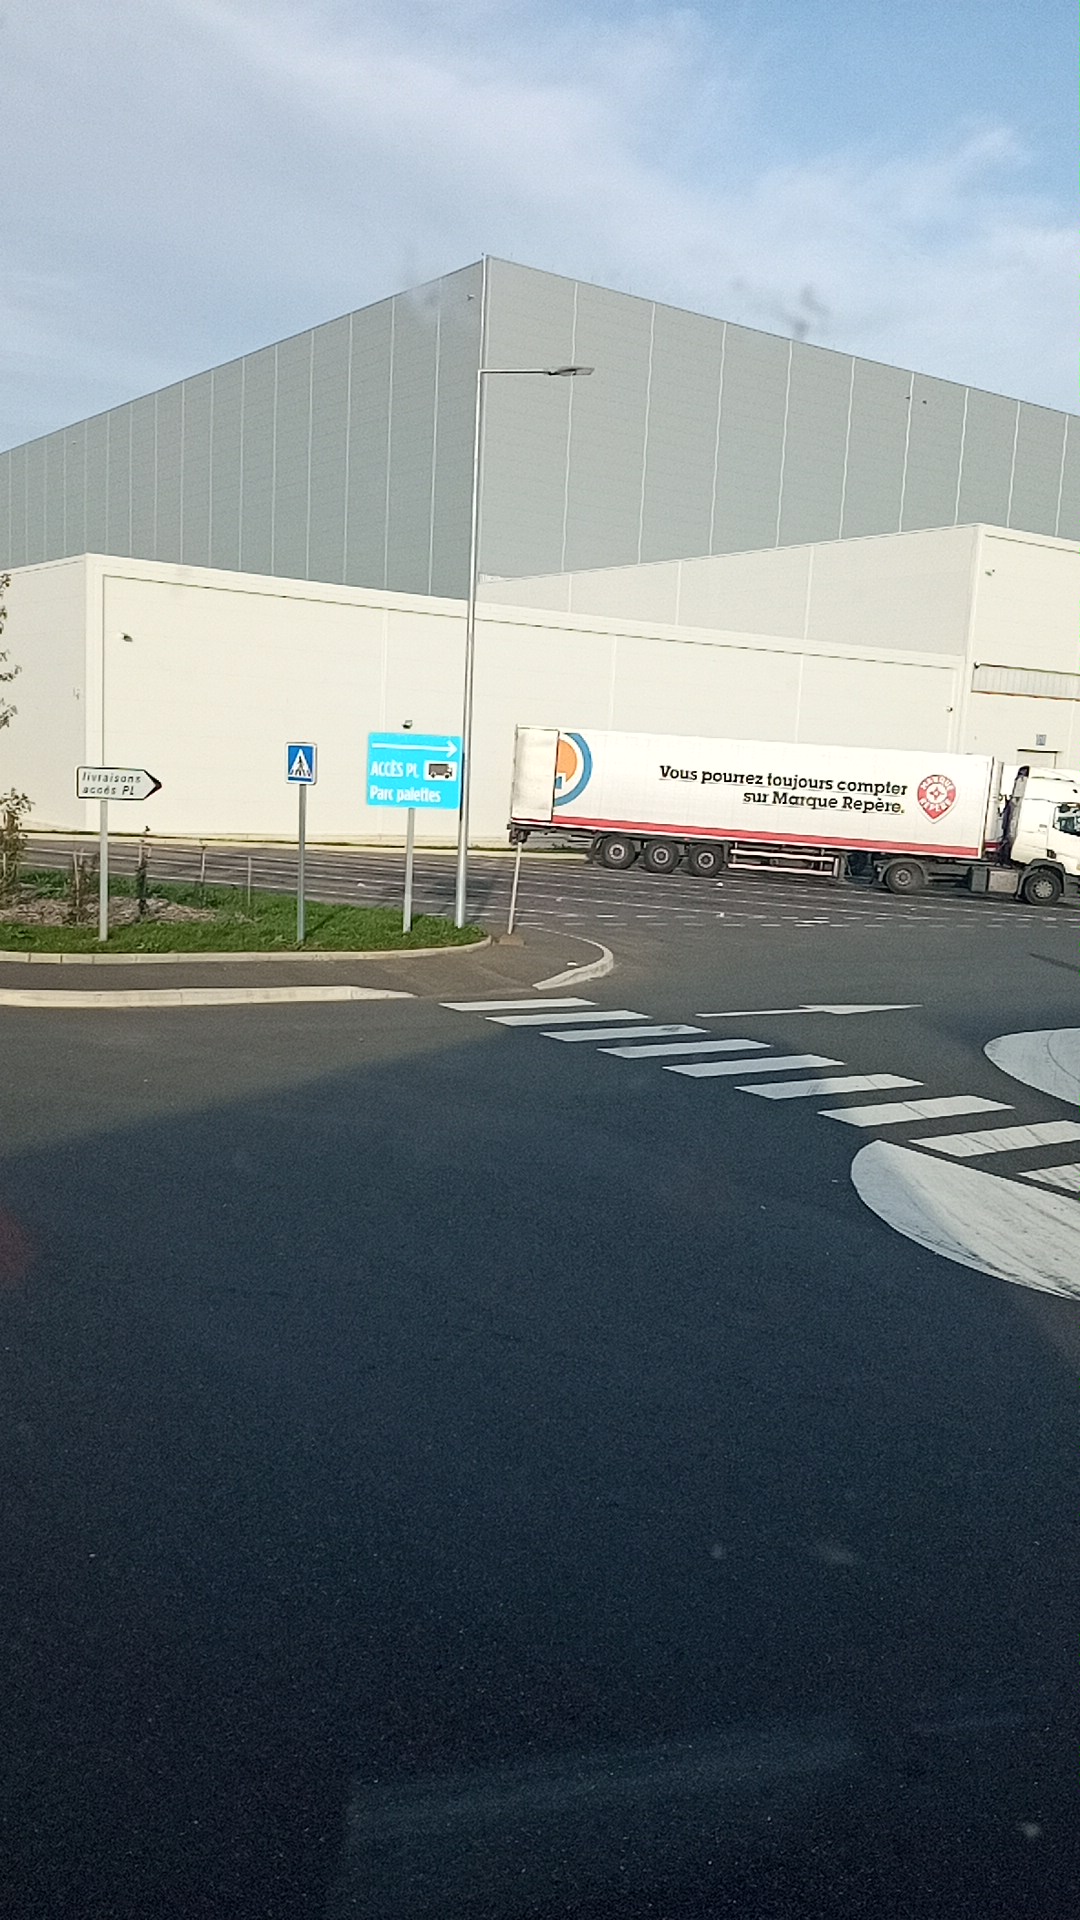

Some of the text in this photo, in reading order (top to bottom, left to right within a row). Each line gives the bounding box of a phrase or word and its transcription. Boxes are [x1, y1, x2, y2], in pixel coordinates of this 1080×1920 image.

[82, 771, 141, 783] livraisons
[370, 759, 420, 779] ACCÈS PL
[659, 765, 908, 796] Vous pourrez toujours compter
[122, 785, 134, 796] PL
[369, 784, 442, 803] Parc palettes
[743, 791, 905, 814] sur Marque Repère.
